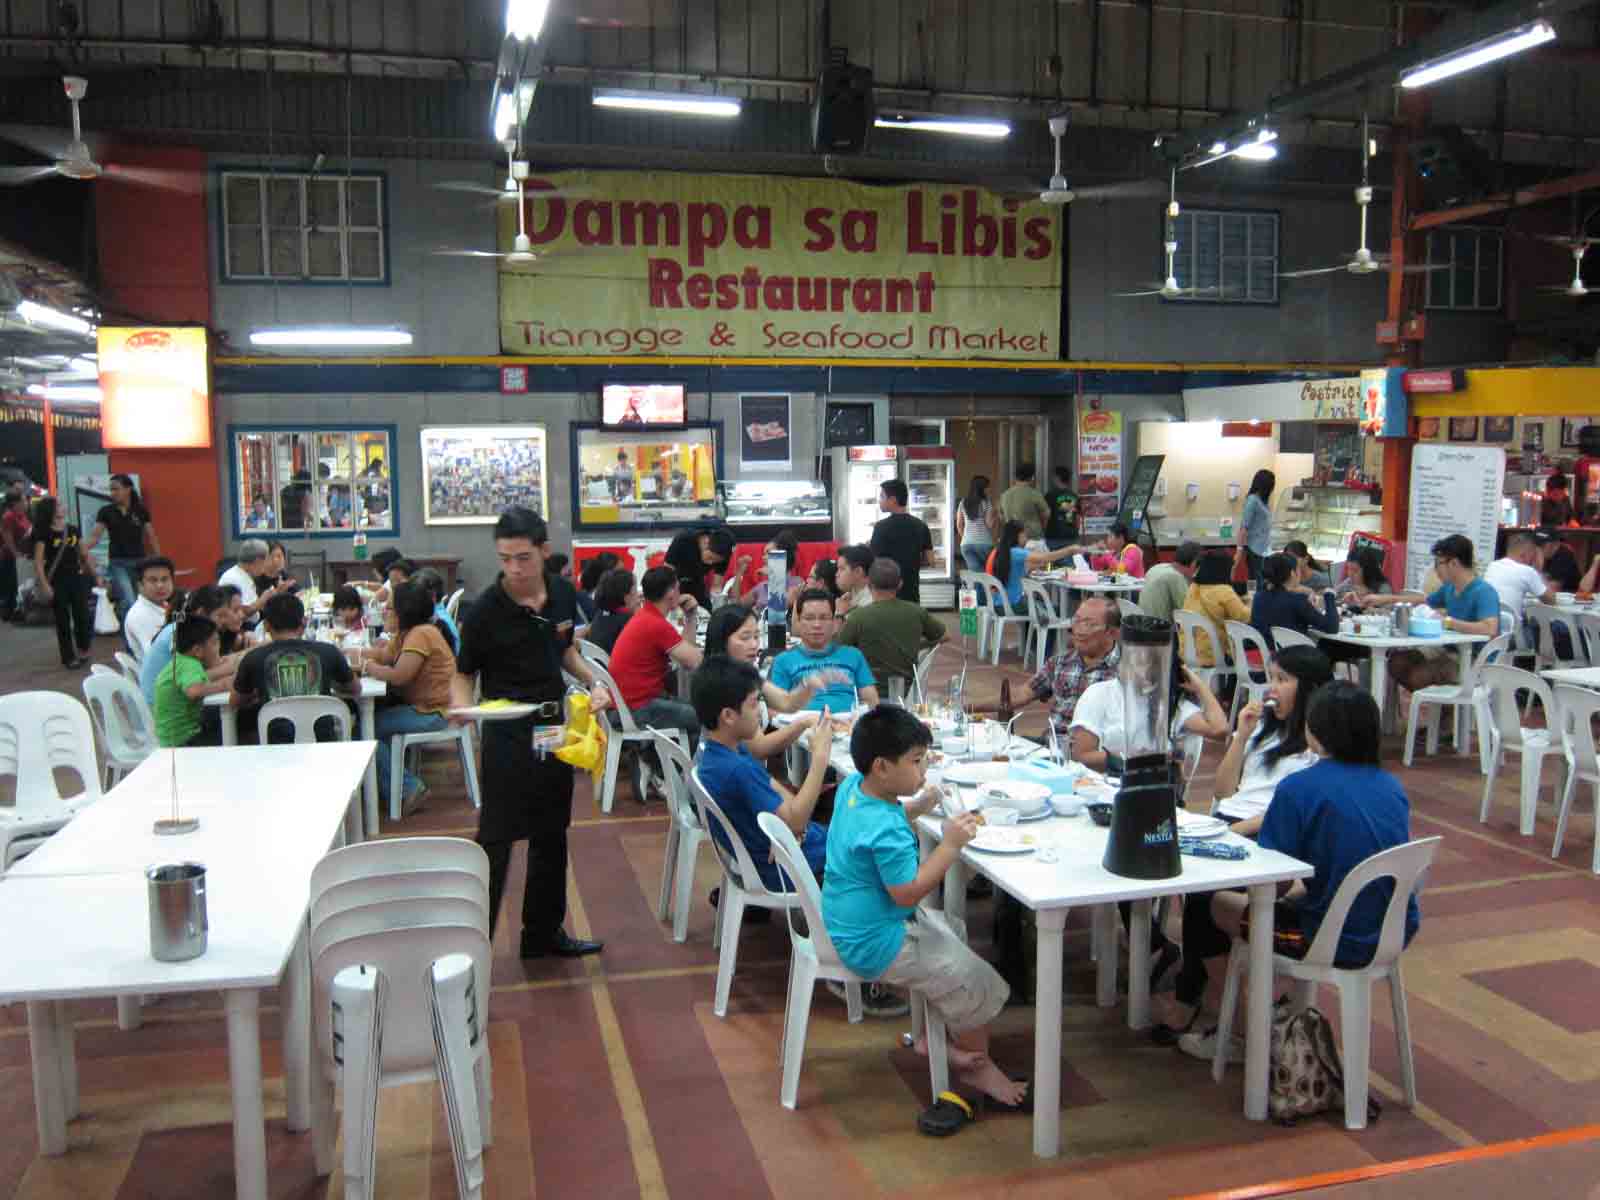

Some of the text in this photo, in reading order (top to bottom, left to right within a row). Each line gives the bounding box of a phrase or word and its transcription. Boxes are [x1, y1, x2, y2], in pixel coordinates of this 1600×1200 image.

[517, 178, 1053, 266] Dampa sa Libis
[648, 258, 934, 313] Restaurant
[514, 320, 1048, 352] Tiangge & Seafood Market
